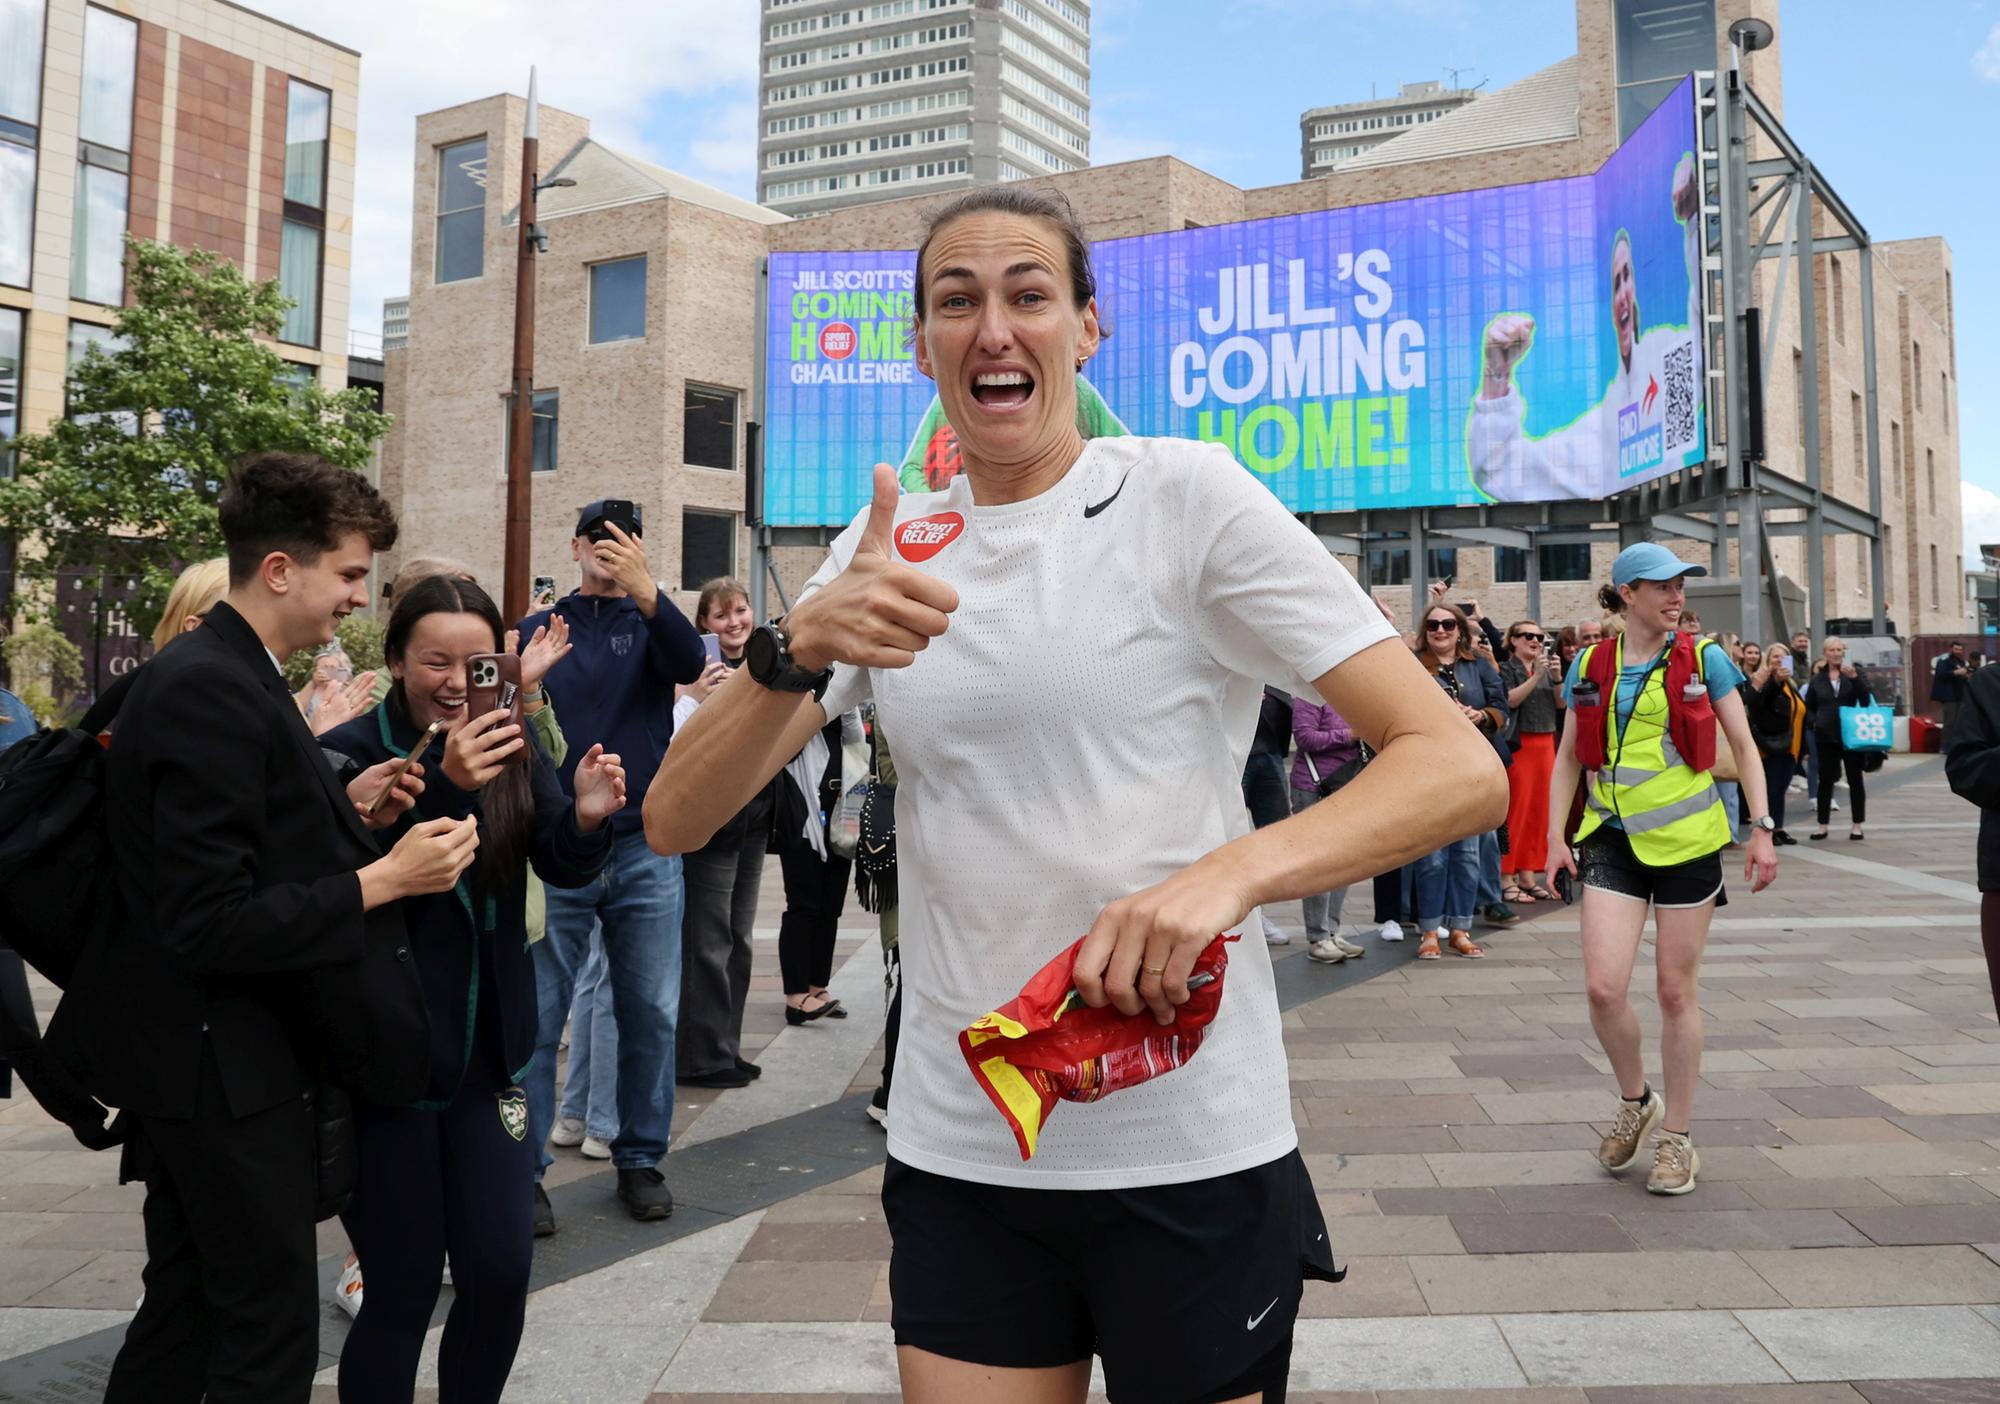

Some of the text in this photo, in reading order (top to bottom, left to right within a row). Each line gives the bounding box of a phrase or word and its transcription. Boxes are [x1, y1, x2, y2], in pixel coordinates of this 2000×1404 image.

[793, 270, 914, 290] JILL SCOTT'S
[1199, 248, 1393, 335] JILL'S
[792, 290, 914, 320] COMING
[791, 363, 913, 384] CHALLENGE
[1170, 319, 1426, 408] COMING
[1199, 396, 1408, 473] HOME!
[901, 529, 949, 544] RELIEF
[907, 521, 958, 535] SPORT
